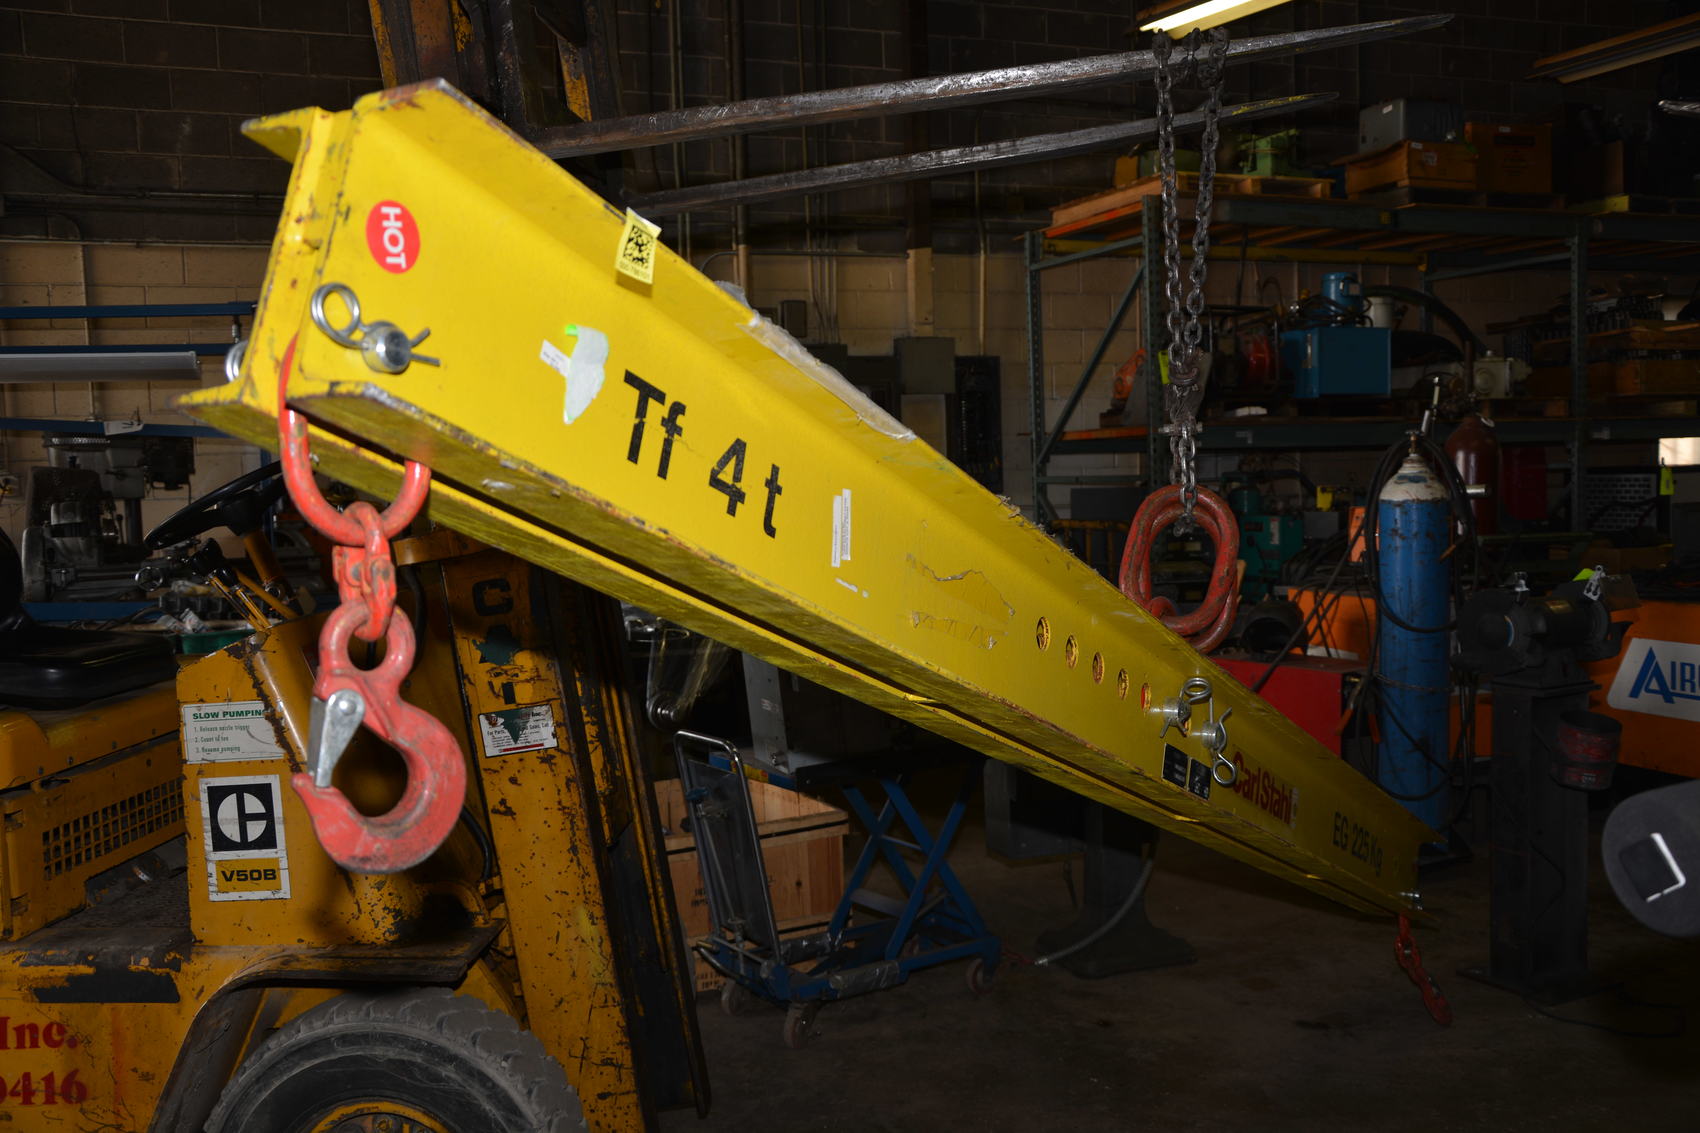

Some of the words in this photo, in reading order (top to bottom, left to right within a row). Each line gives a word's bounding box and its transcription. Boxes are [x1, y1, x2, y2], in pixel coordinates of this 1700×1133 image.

[380, 205, 407, 270] HOT
[624, 369, 686, 480] Tf
[709, 438, 747, 517] 4
[764, 463, 783, 538] t
[1628, 646, 1700, 704] AIR
[192, 711, 219, 720] SLOW
[1333, 810, 1349, 850] EG
[220, 868, 278, 882] V50B
[0, 1016, 78, 1050] Inc.
